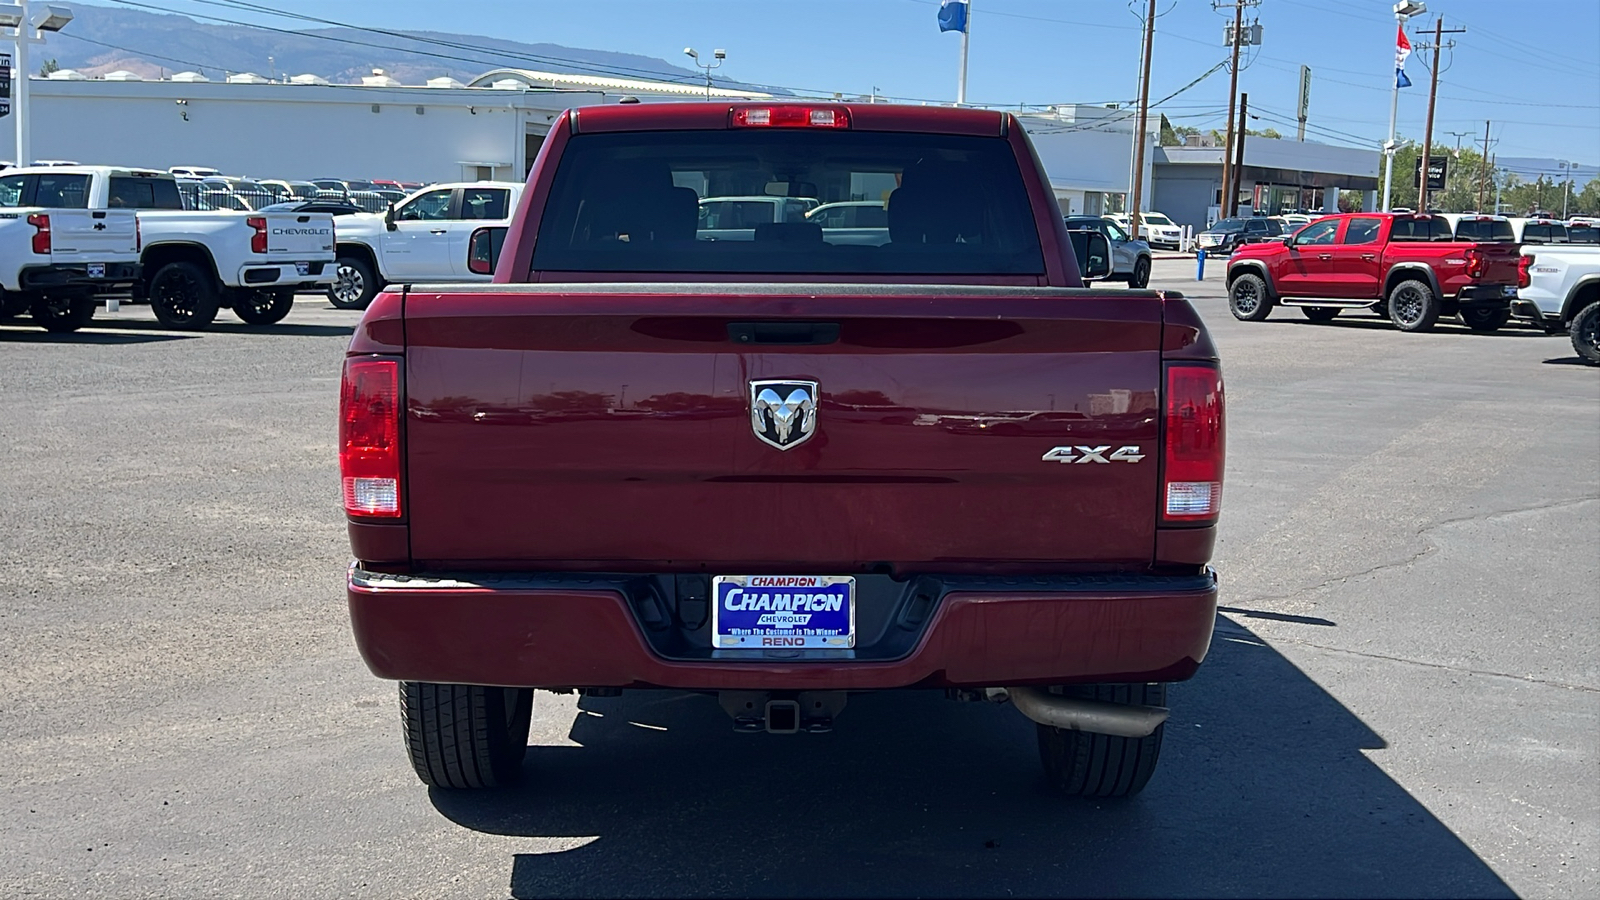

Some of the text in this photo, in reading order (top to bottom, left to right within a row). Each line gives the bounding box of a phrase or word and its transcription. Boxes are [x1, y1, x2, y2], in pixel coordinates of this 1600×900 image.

[1042, 445, 1146, 464] 4X4
[751, 577, 817, 587] CHAMPION
[761, 615, 808, 623] CHEVROLET
[753, 628, 765, 636] The
[766, 628, 795, 636] Customer
[804, 628, 815, 636] The
[762, 637, 805, 646] RENO
